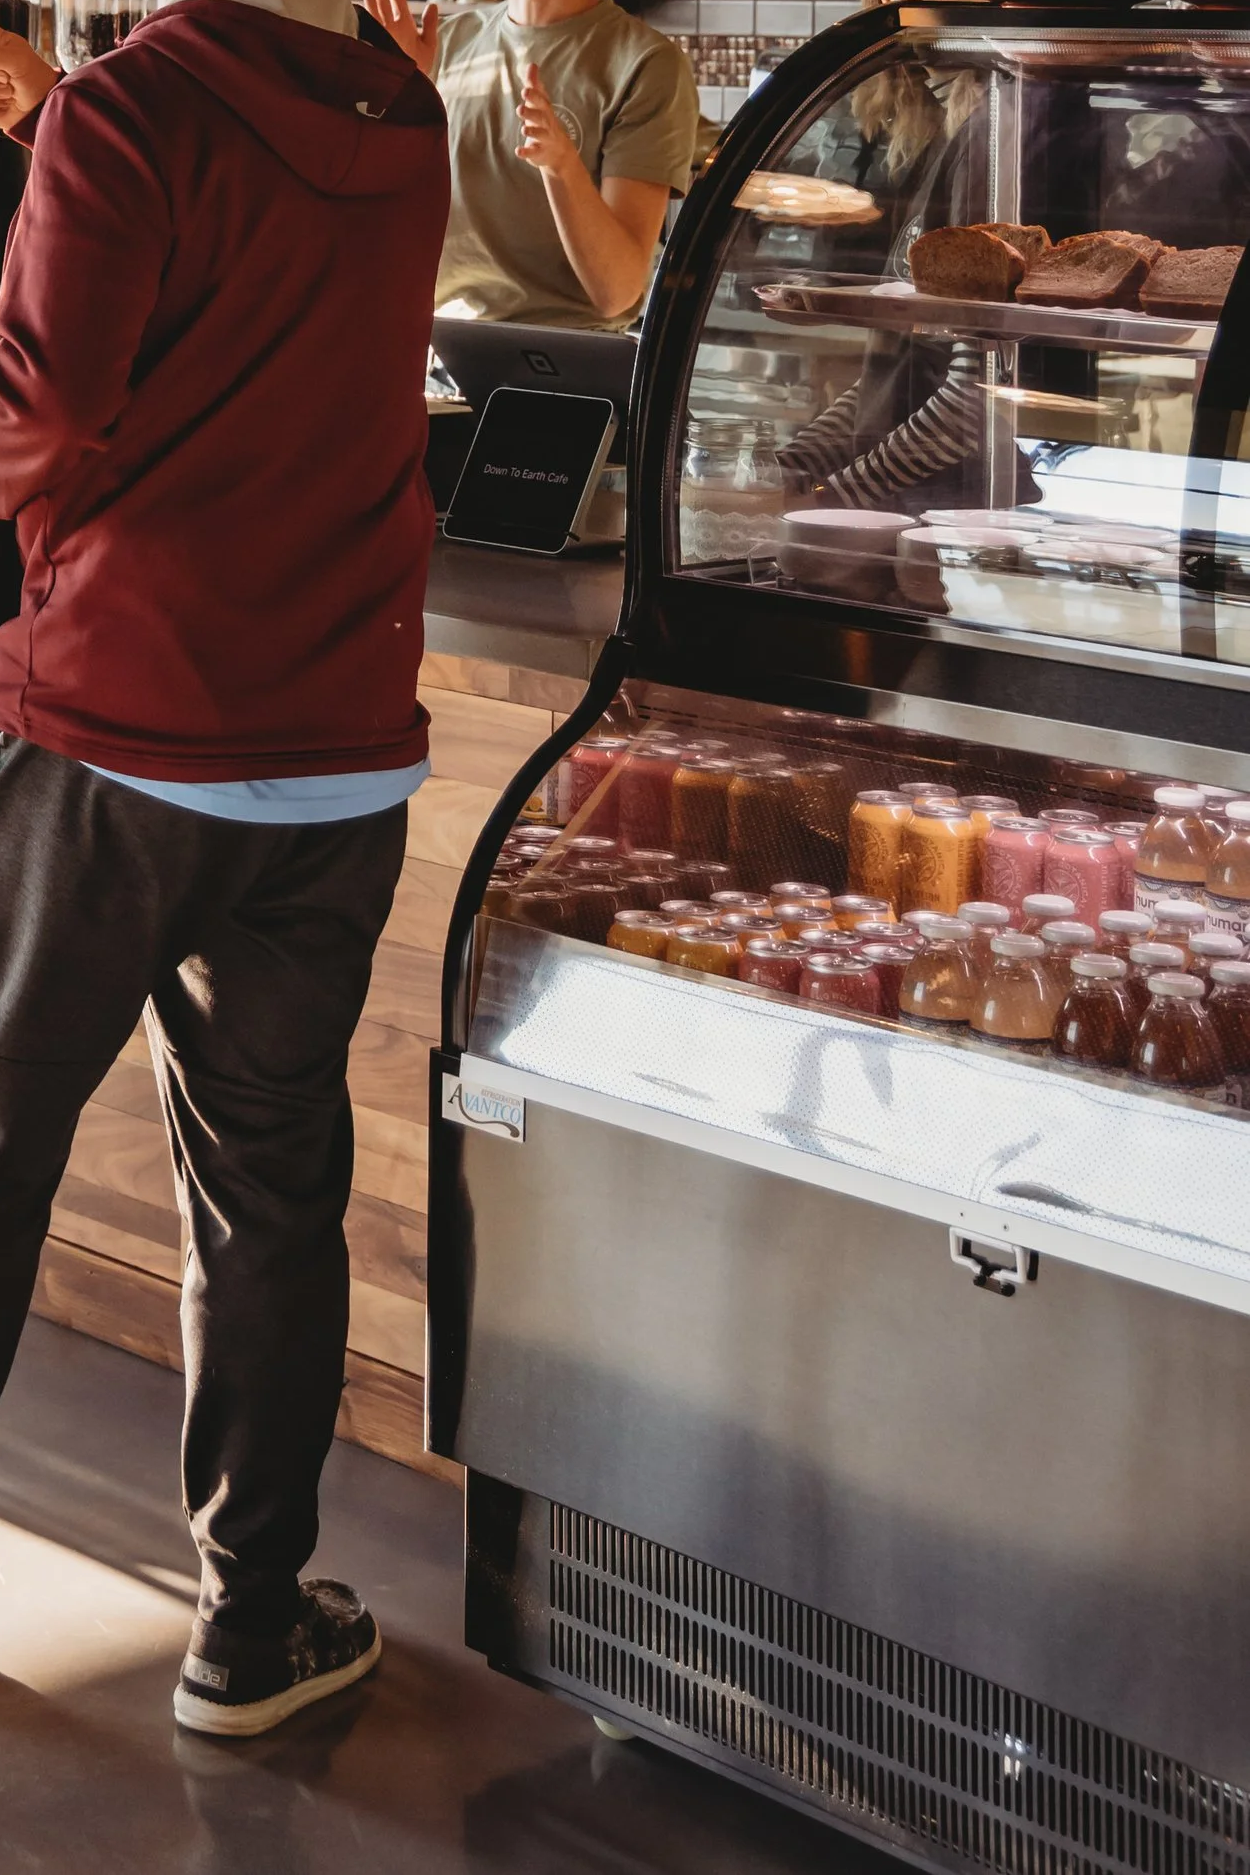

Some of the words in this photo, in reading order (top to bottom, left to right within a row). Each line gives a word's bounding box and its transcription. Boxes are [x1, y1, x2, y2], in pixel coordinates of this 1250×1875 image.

[483, 463, 508, 476] Down
[510, 466, 521, 478] To
[521, 468, 546, 481] Earth
[547, 472, 569, 485] Cafe
[447, 1083, 522, 1129] AVANTCO
